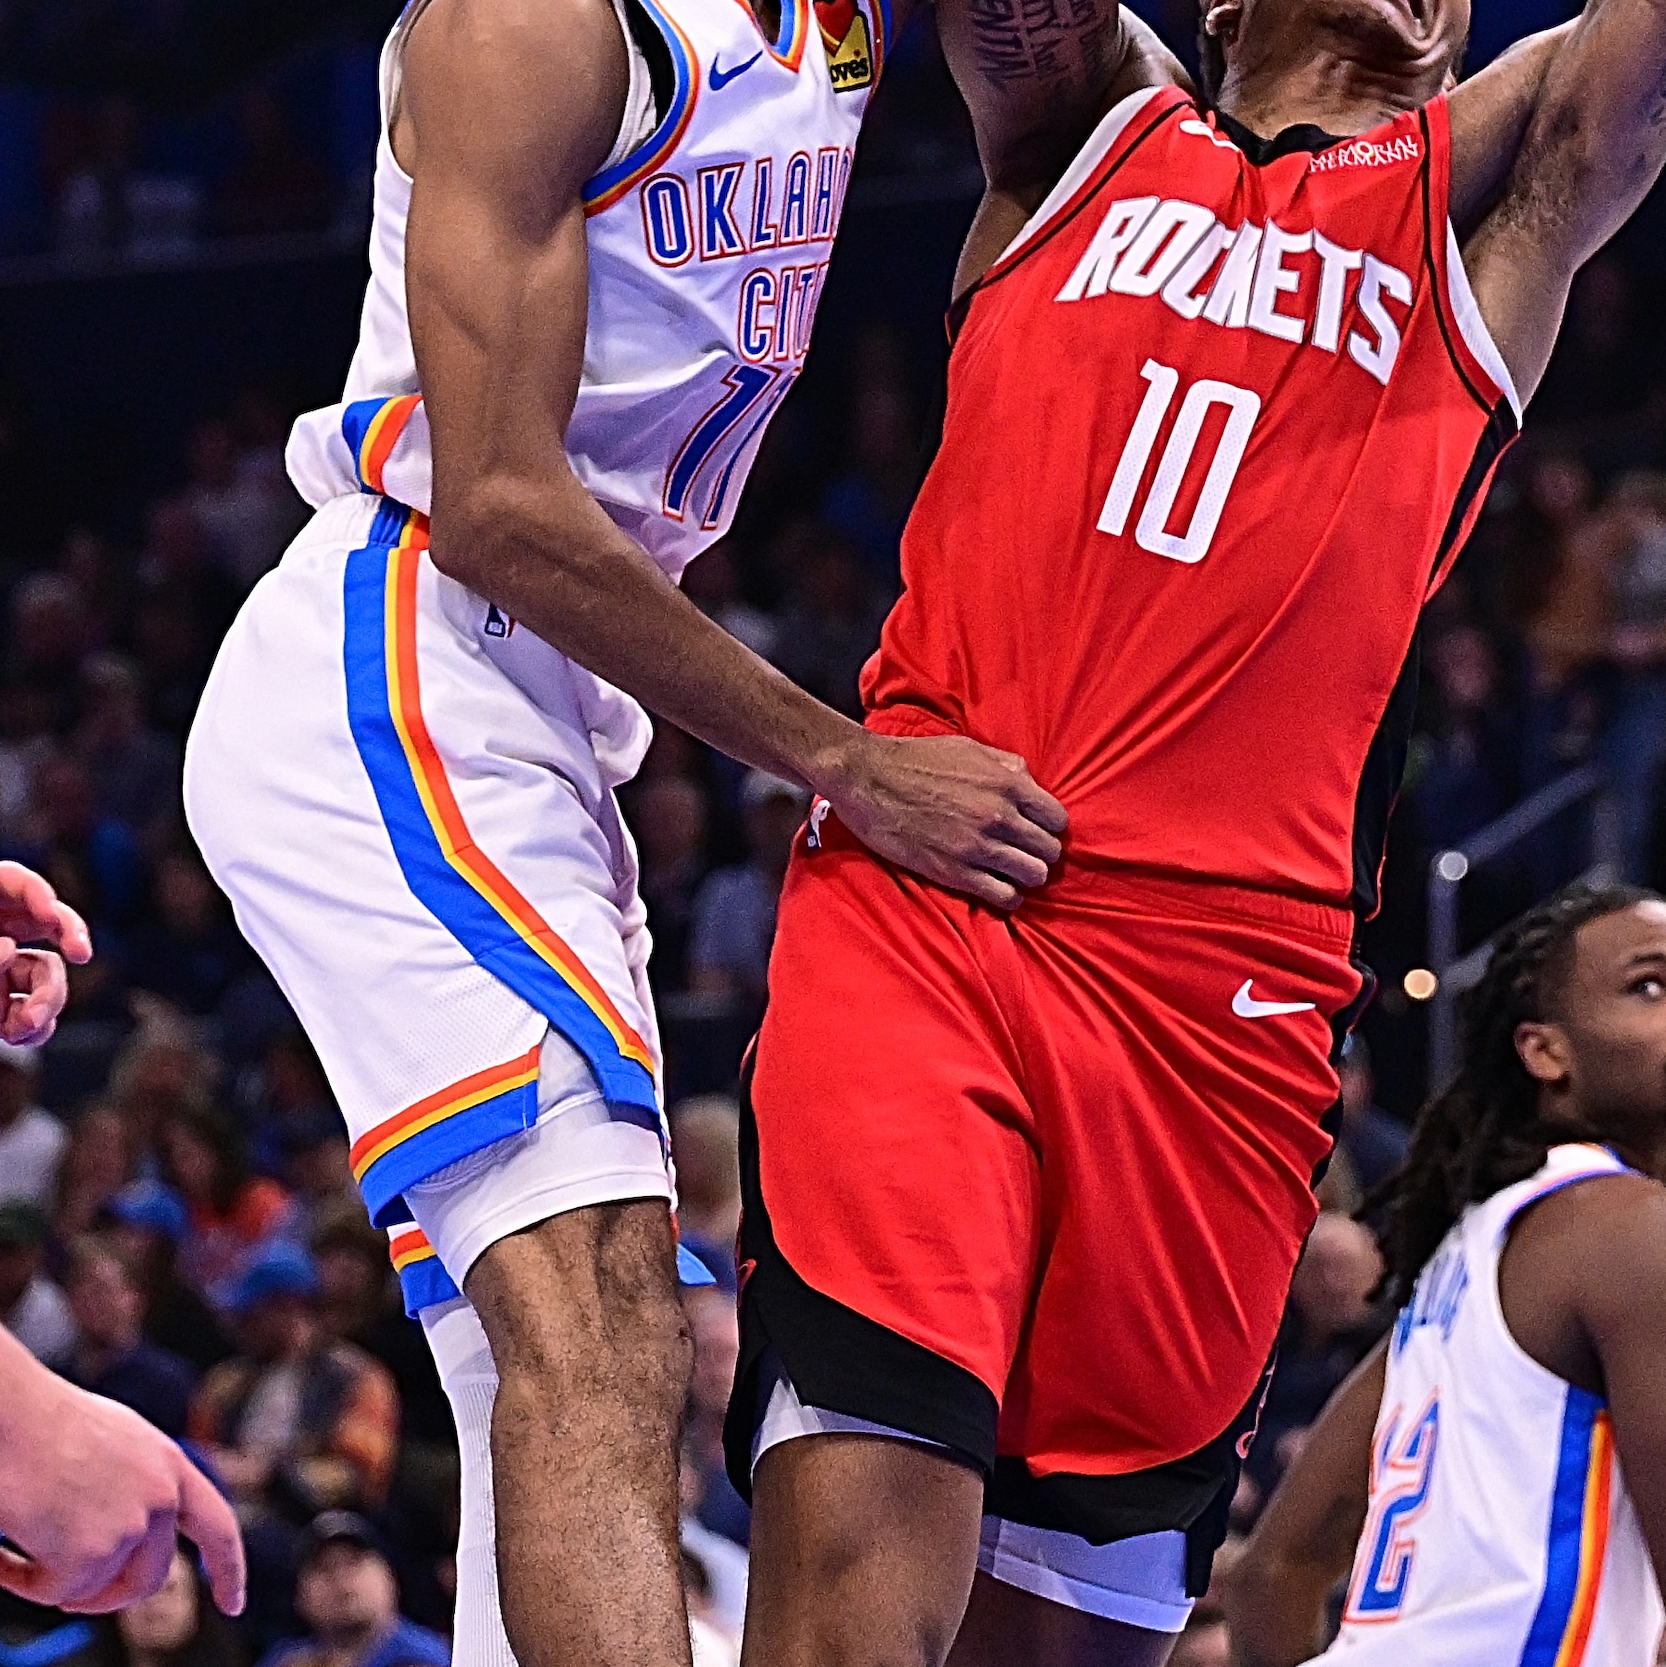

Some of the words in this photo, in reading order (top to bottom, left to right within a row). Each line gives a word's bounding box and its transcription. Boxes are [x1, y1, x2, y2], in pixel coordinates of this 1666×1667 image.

[830, 57, 869, 84] oves
[640, 146, 854, 268] OKLAH
[738, 260, 831, 364] CIT
[1053, 195, 1413, 387] ROCKETS
[1095, 357, 1262, 565] 10
